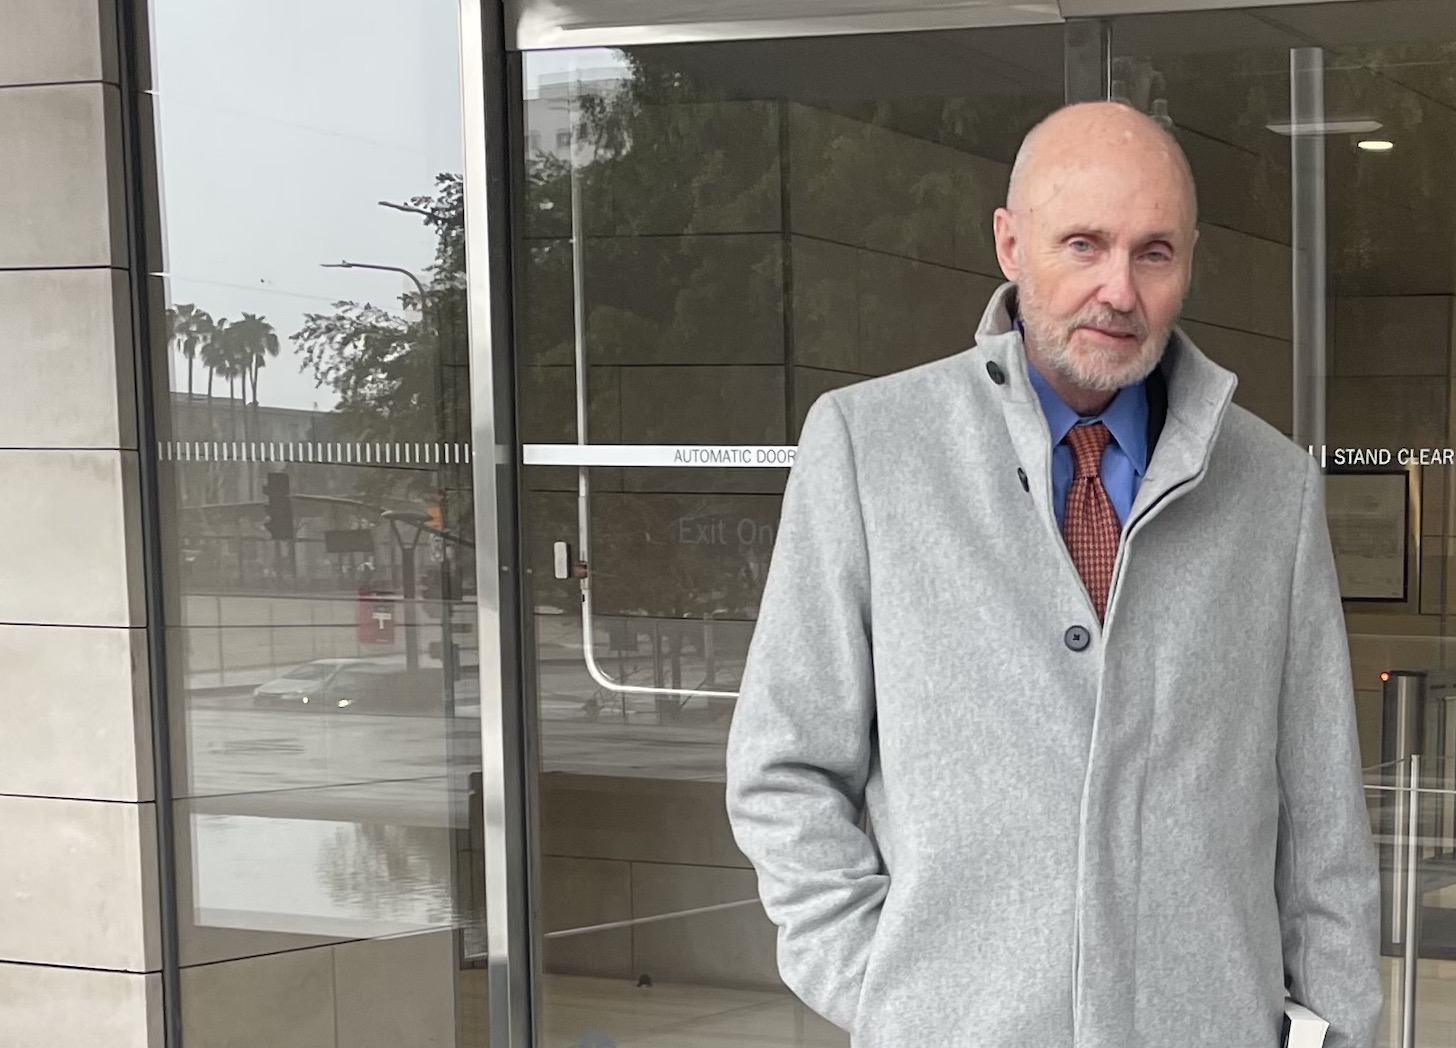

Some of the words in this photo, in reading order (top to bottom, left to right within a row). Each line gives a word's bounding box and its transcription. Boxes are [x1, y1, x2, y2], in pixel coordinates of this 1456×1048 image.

[674, 449, 752, 464] AUTOMATIC
[1334, 448, 1391, 466] STAND
[1397, 448, 1455, 466] CLEAR
[679, 517, 728, 545] Exit
[737, 518, 778, 545] On
